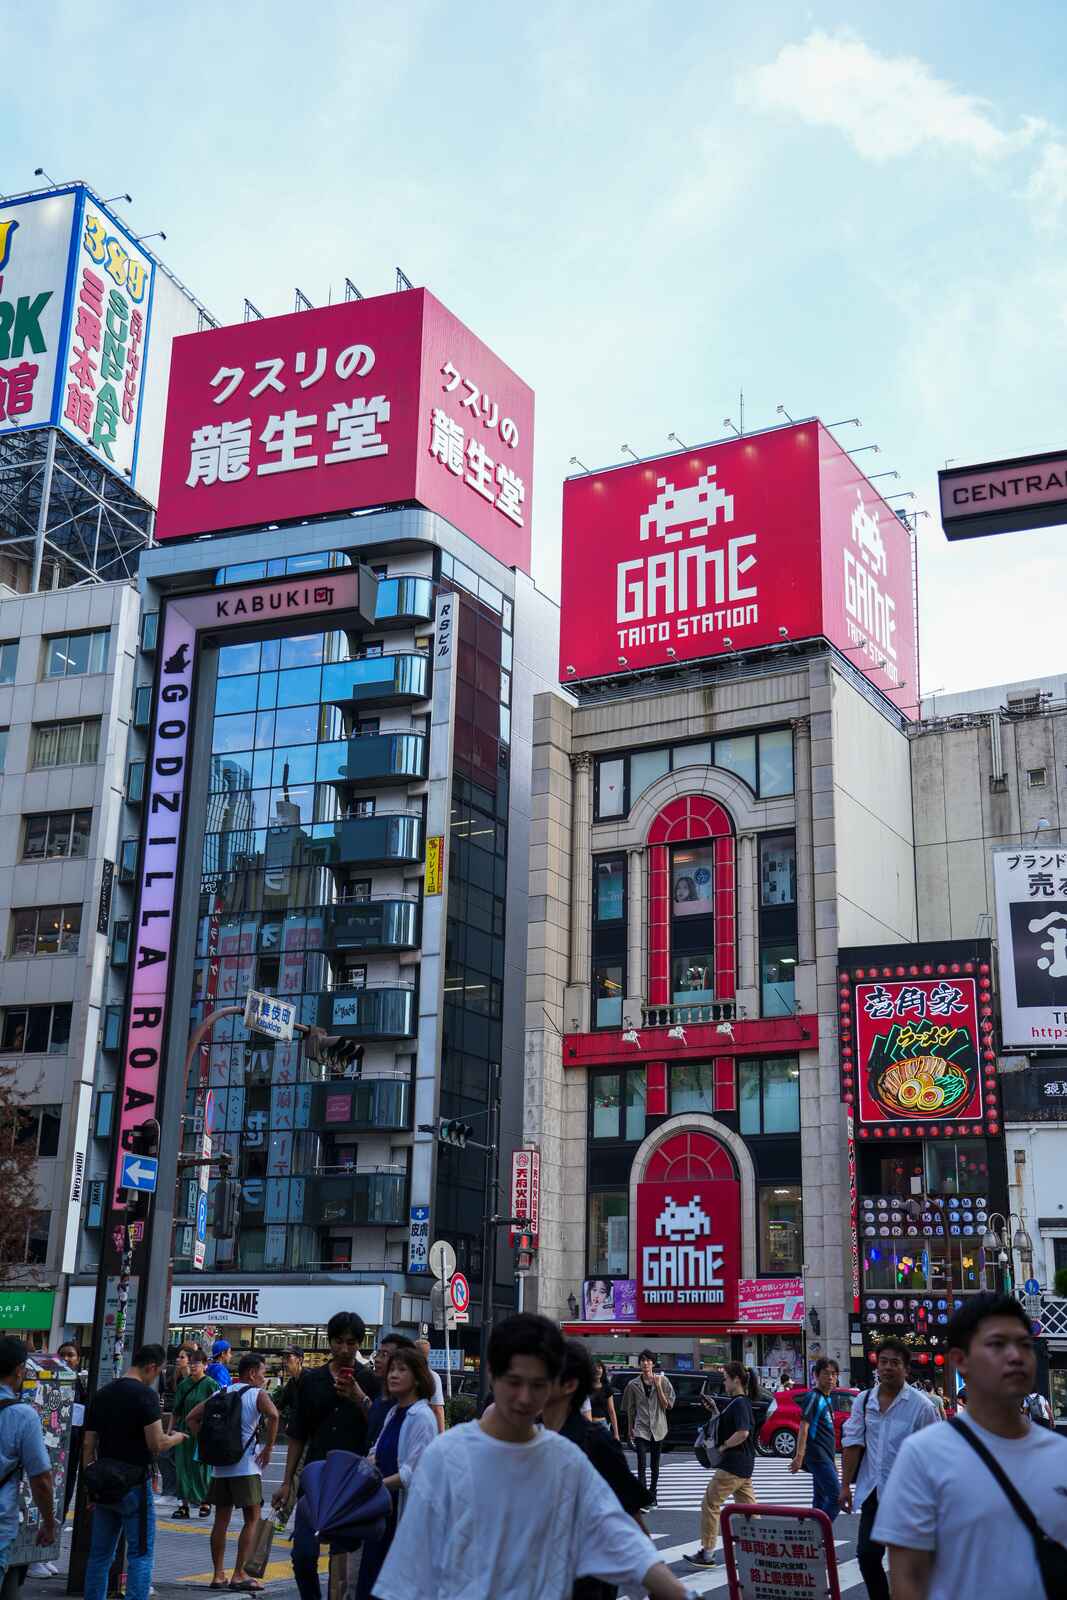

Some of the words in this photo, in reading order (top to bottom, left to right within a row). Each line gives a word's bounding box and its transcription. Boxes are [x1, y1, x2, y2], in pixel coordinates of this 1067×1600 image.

[93, 288, 129, 462] SUNPARK
[122, 308, 142, 425] SHINJUKU
[210, 343, 377, 404] クスリの
[440, 362, 519, 449] クスリの
[185, 395, 391, 488] 龍生堂
[429, 408, 525, 528] 龍生堂
[953, 470, 1067, 504] CENTRA
[617, 534, 757, 624] GAME
[844, 548, 896, 660] GAME
[438, 604, 450, 656] RSビル
[617, 621, 669, 649] TAITO
[677, 604, 758, 638] STATION
[137, 684, 189, 970] GODZILLA
[1008, 854, 1067, 869] ブランド
[897, 1026, 957, 1047] ラーメン
[72, 1152, 84, 1203] HOMEGAME
[643, 1245, 724, 1287] GAME
[179, 1292, 260, 1315] HOMEGAME
[643, 1290, 674, 1304] TAITO
[677, 1290, 724, 1304] STATION
